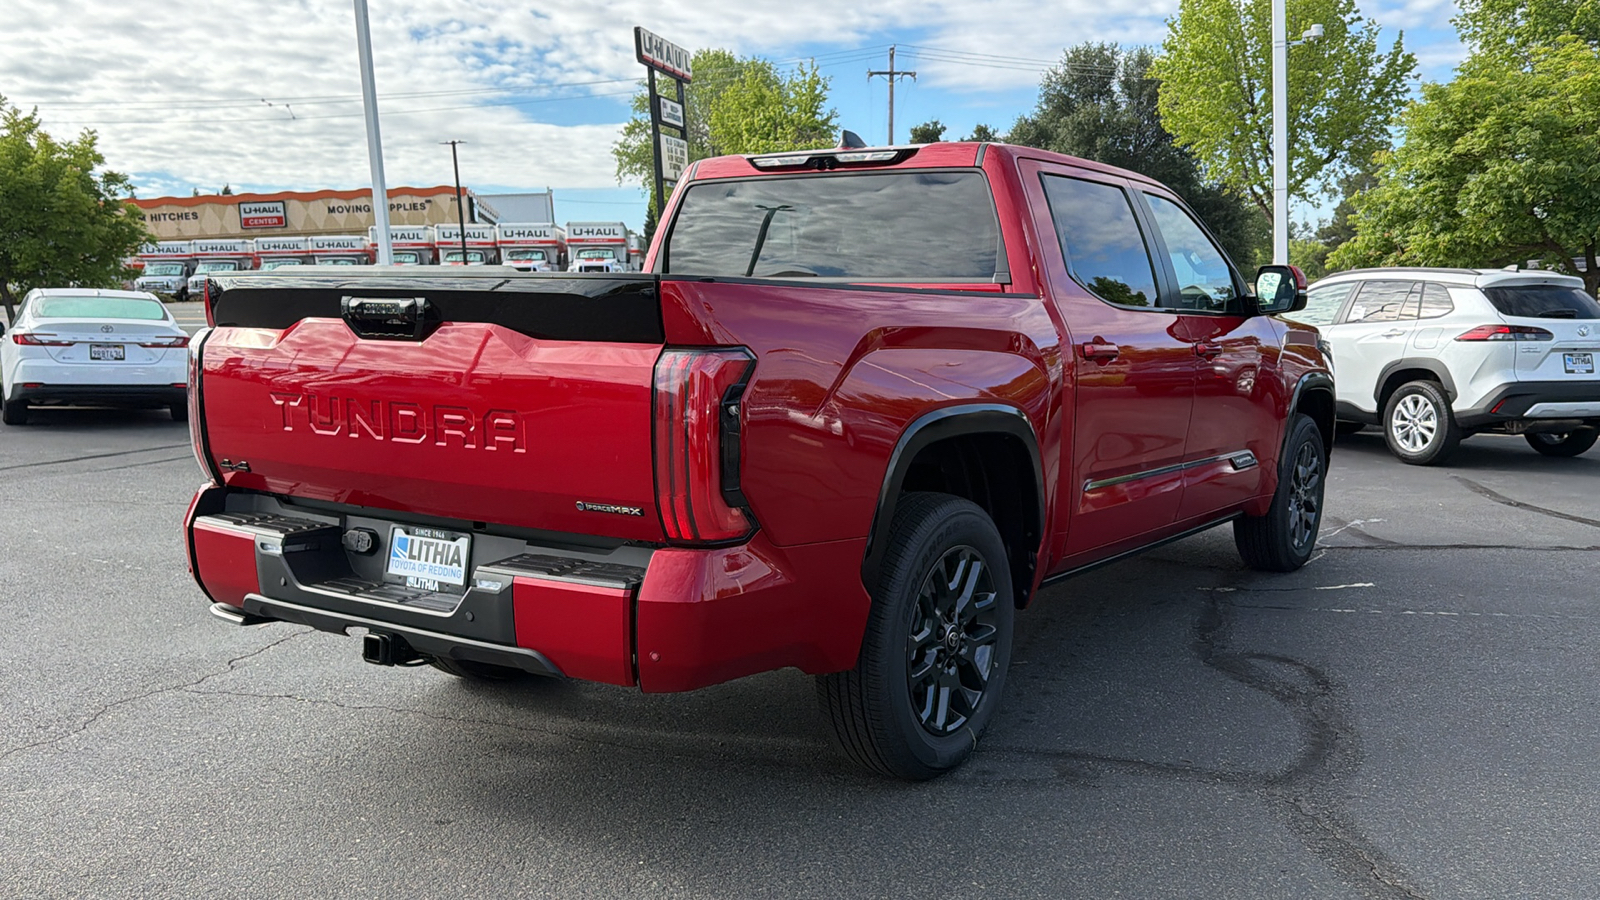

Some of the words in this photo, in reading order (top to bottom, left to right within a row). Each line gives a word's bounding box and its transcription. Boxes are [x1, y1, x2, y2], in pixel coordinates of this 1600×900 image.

[642, 33, 691, 73] U-HAUL
[243, 205, 281, 215] U-HAUL
[327, 204, 371, 214] MOVING
[389, 202, 426, 212] PPLIES
[150, 211, 199, 222] HITCHES
[248, 216, 279, 226] CENTER
[503, 229, 550, 238] U-HAUL
[572, 228, 619, 237] U-HAUL
[315, 241, 356, 249] U-HAUL
[269, 391, 527, 454] TUNDRA
[414, 528, 432, 537] SINCE
[432, 530, 445, 539] 1946
[407, 538, 462, 568] LITHIA
[390, 558, 417, 571] TOYOTA
[417, 563, 428, 573] OF
[428, 564, 462, 579] REDDING
[413, 576, 440, 592] LITHIA
